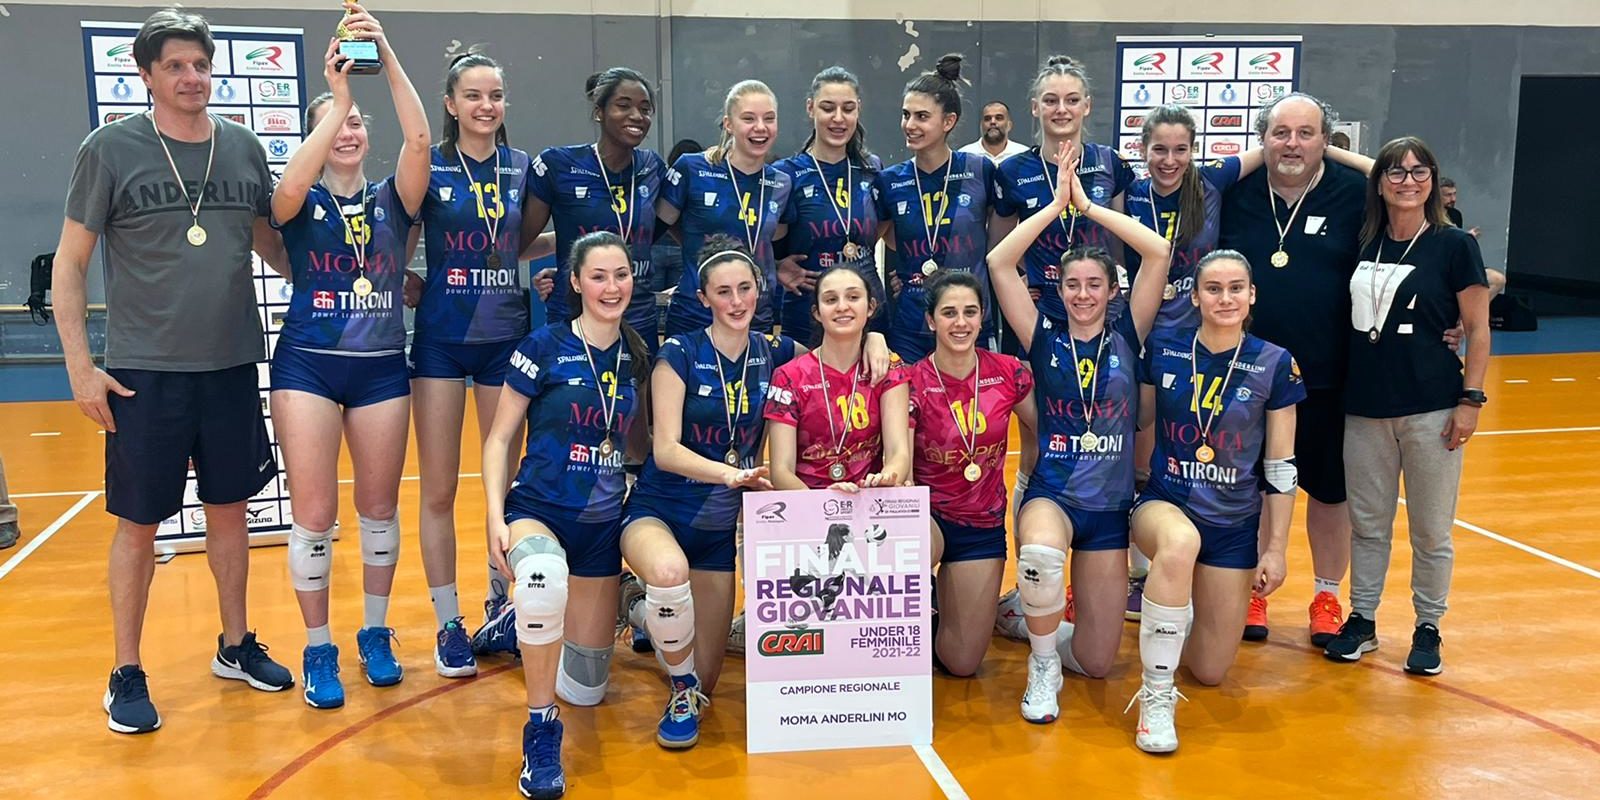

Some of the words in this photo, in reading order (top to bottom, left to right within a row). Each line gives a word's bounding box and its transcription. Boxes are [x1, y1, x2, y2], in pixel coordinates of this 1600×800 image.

[1212, 116, 1241, 127] CRAI
[469, 182, 505, 219] 13
[610, 185, 628, 214] 3
[835, 178, 849, 209] 6
[738, 192, 757, 226] 4
[922, 191, 951, 227] 12
[1160, 211, 1177, 241] 7
[307, 250, 397, 273] MOMA
[338, 291, 393, 310] TIRONI
[312, 311, 338, 319] power
[557, 354, 588, 365] SPALDING
[1162, 348, 1193, 361] SPALDING
[601, 371, 624, 400] 2
[1079, 358, 1095, 388] 9
[1190, 373, 1224, 417] 14
[836, 392, 870, 433] 18
[951, 398, 987, 436] 16
[1163, 418, 1243, 451] MOMA
[566, 465, 591, 473] power
[1179, 460, 1237, 484] TIRONI
[840, 500, 853, 508] E-R
[756, 540, 921, 578] FINALE
[756, 574, 921, 600] REGIONALE
[756, 596, 921, 623] GIOVANILE
[761, 631, 821, 653] CRAI
[850, 636, 921, 648] FEMMINILE
[859, 626, 905, 637] UNDER
[907, 625, 921, 636] 18
[872, 647, 921, 658] 2021-22
[780, 684, 837, 695] CAMPIONE
[839, 681, 901, 692] REGIONALE
[780, 715, 818, 726] MOMA
[821, 711, 885, 724] ANDERLINI
[887, 711, 907, 721] MO
